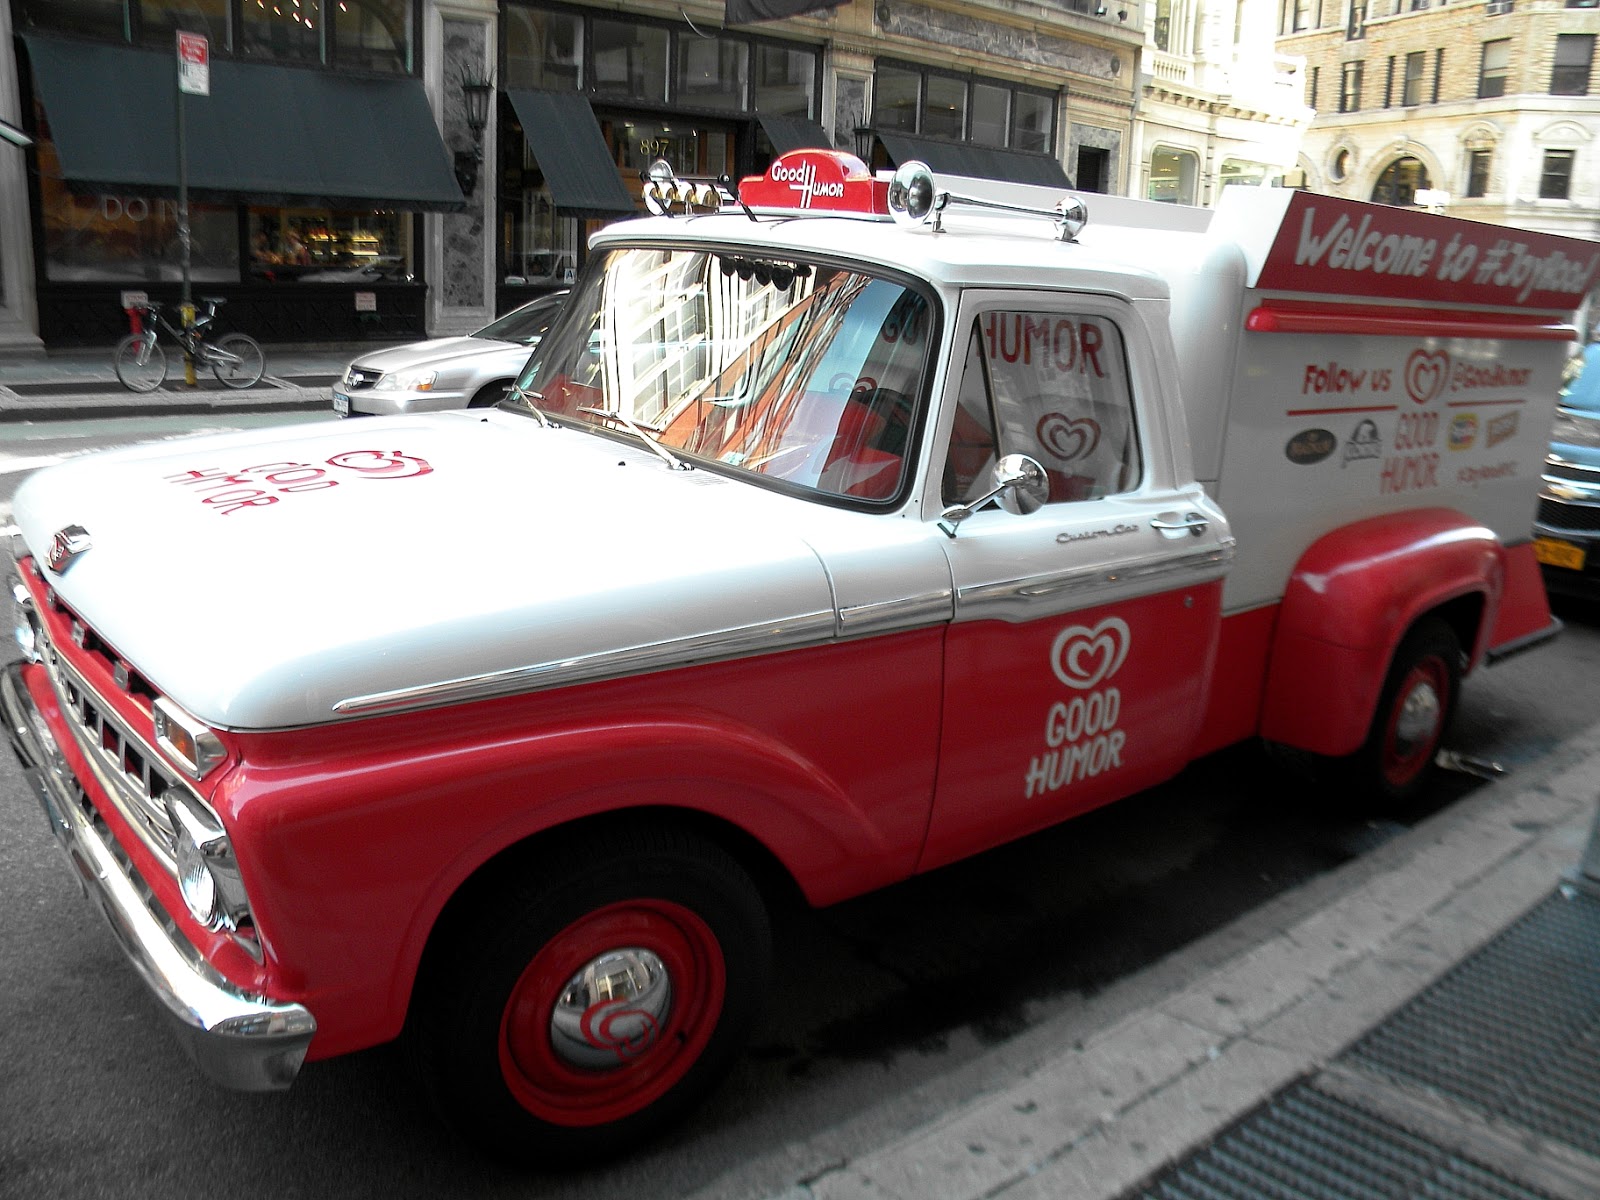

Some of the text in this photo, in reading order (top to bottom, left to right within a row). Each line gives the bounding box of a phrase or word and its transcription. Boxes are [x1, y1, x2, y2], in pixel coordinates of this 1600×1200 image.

[640, 138, 670, 156] 897
[771, 160, 807, 182] Good
[1294, 207, 1438, 278] Welcome
[1436, 232, 1478, 282] to
[975, 312, 1105, 379] HUMOR
[1302, 362, 1393, 394] Follow us
[1393, 411, 1440, 450] GOOD
[1380, 452, 1440, 493] HUMOR
[1046, 687, 1121, 747] GOOD
[1025, 730, 1127, 799] HUMOR
